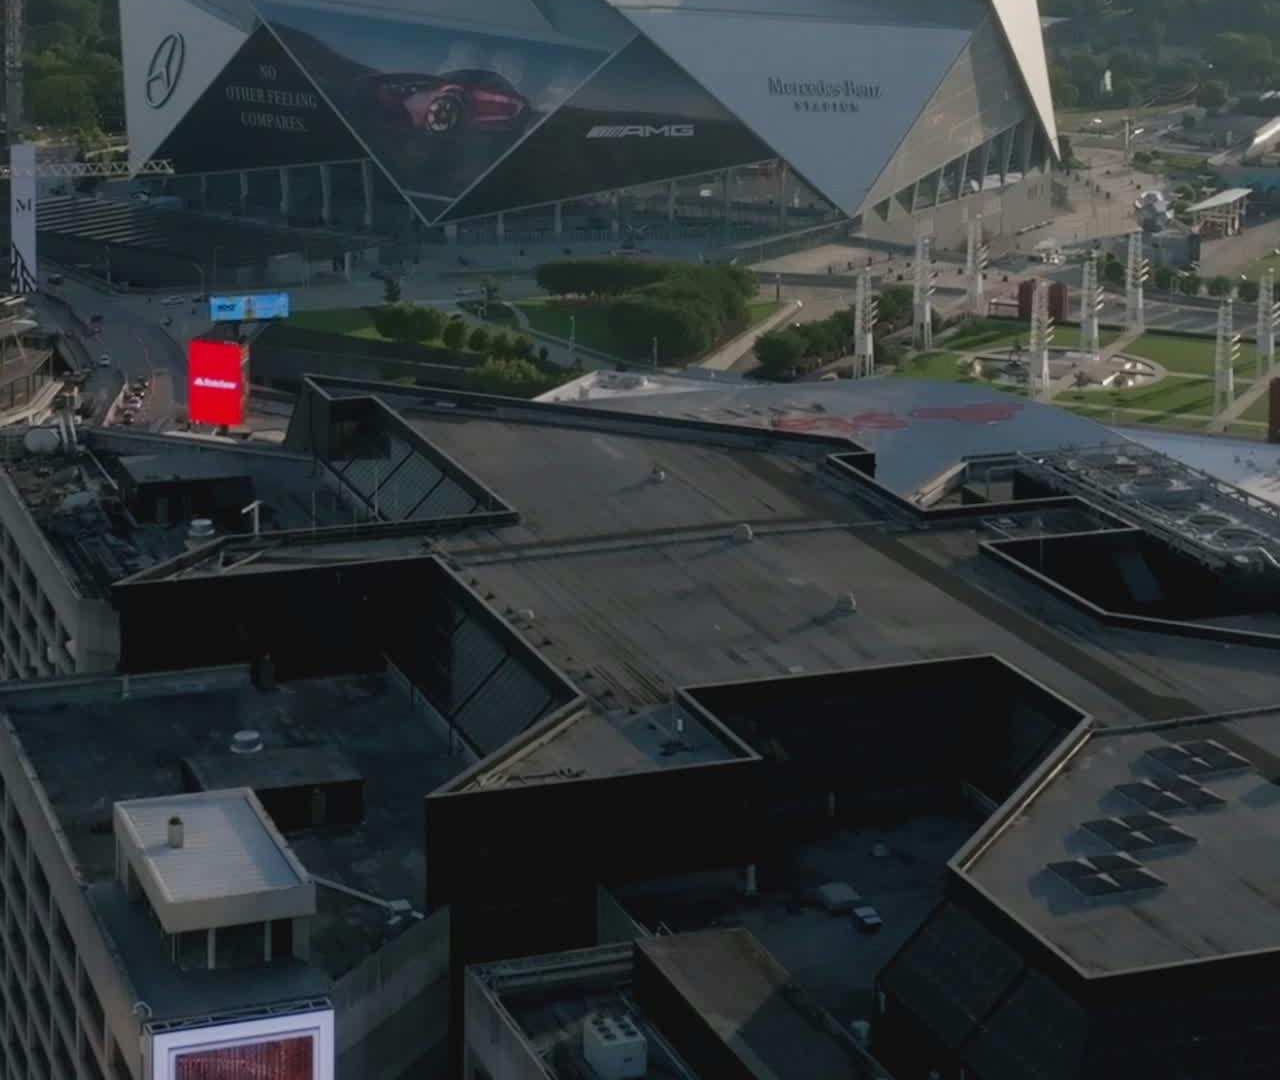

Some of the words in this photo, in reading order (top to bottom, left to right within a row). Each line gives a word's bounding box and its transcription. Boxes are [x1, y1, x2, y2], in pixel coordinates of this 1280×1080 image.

[258, 64, 277, 80] NO
[768, 76, 881, 98] Mercedes-Benz
[623, 124, 696, 137] AMG
